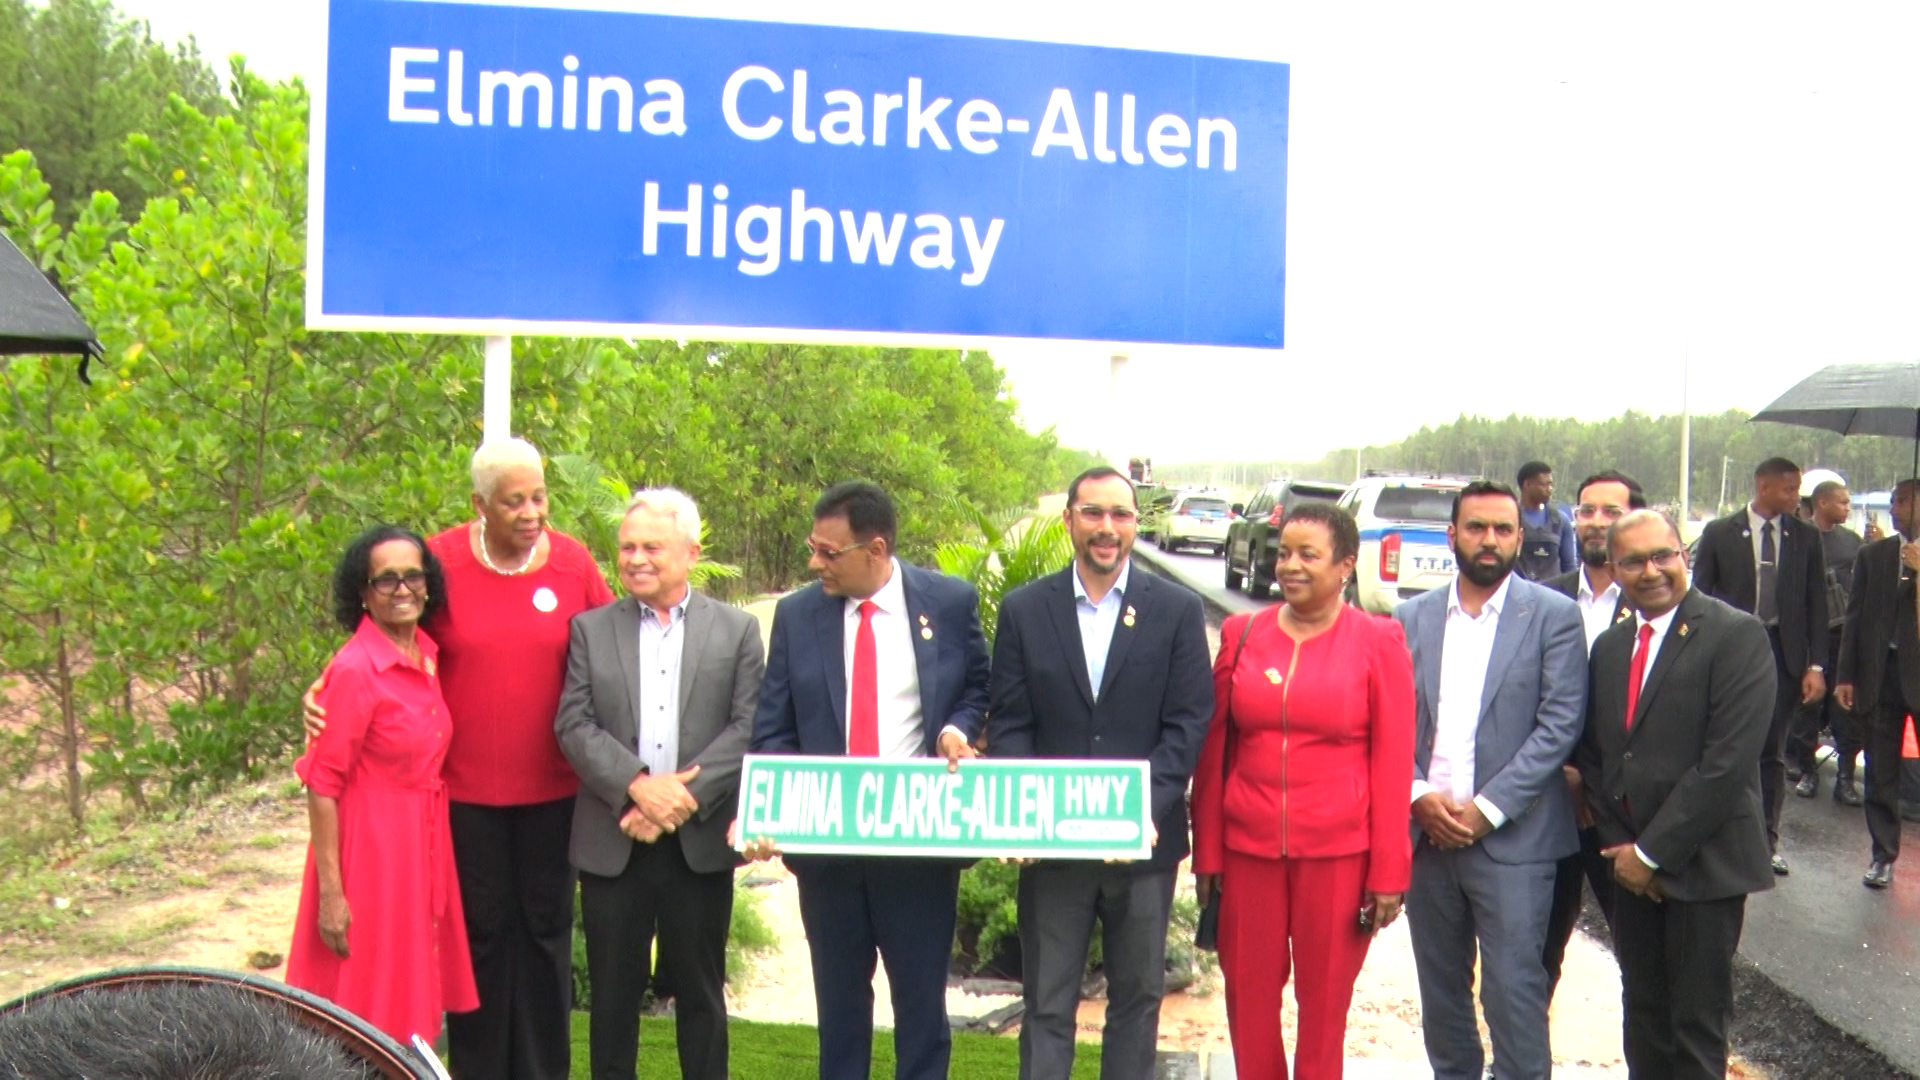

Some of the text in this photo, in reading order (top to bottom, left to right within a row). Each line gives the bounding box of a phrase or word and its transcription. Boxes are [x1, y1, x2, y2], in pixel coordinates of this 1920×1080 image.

[389, 47, 1237, 171] Elmina Clarke-Allen
[643, 182, 1004, 286] Highway
[1412, 556, 1459, 571] T.T.P.
[746, 770, 1129, 841] ELMINA CLARKE-ALLEN HWY
